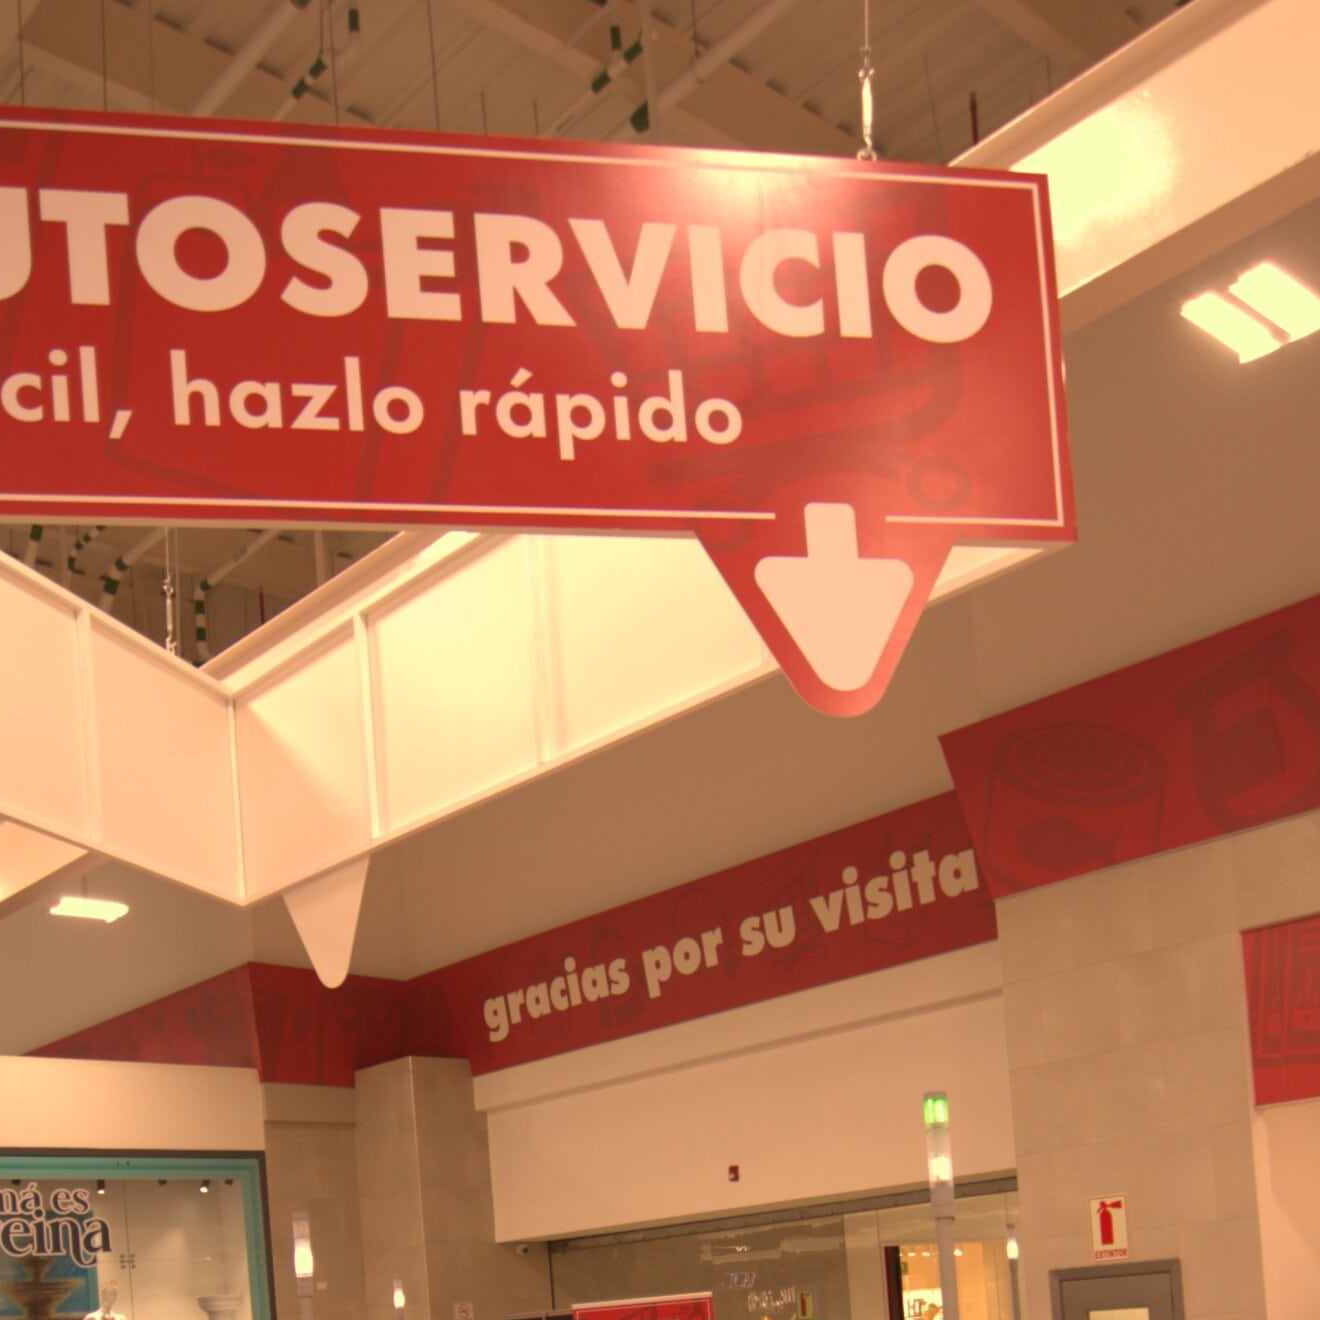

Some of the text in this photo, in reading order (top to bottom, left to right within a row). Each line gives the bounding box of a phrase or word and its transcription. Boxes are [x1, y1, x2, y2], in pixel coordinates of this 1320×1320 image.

[169, 349, 425, 434] hazlo
[458, 367, 743, 461] rápido
[483, 847, 980, 1042] gracias por su visita
[50, 1188, 90, 1214] es
[1094, 1249, 1128, 1260] EXTINTOR
